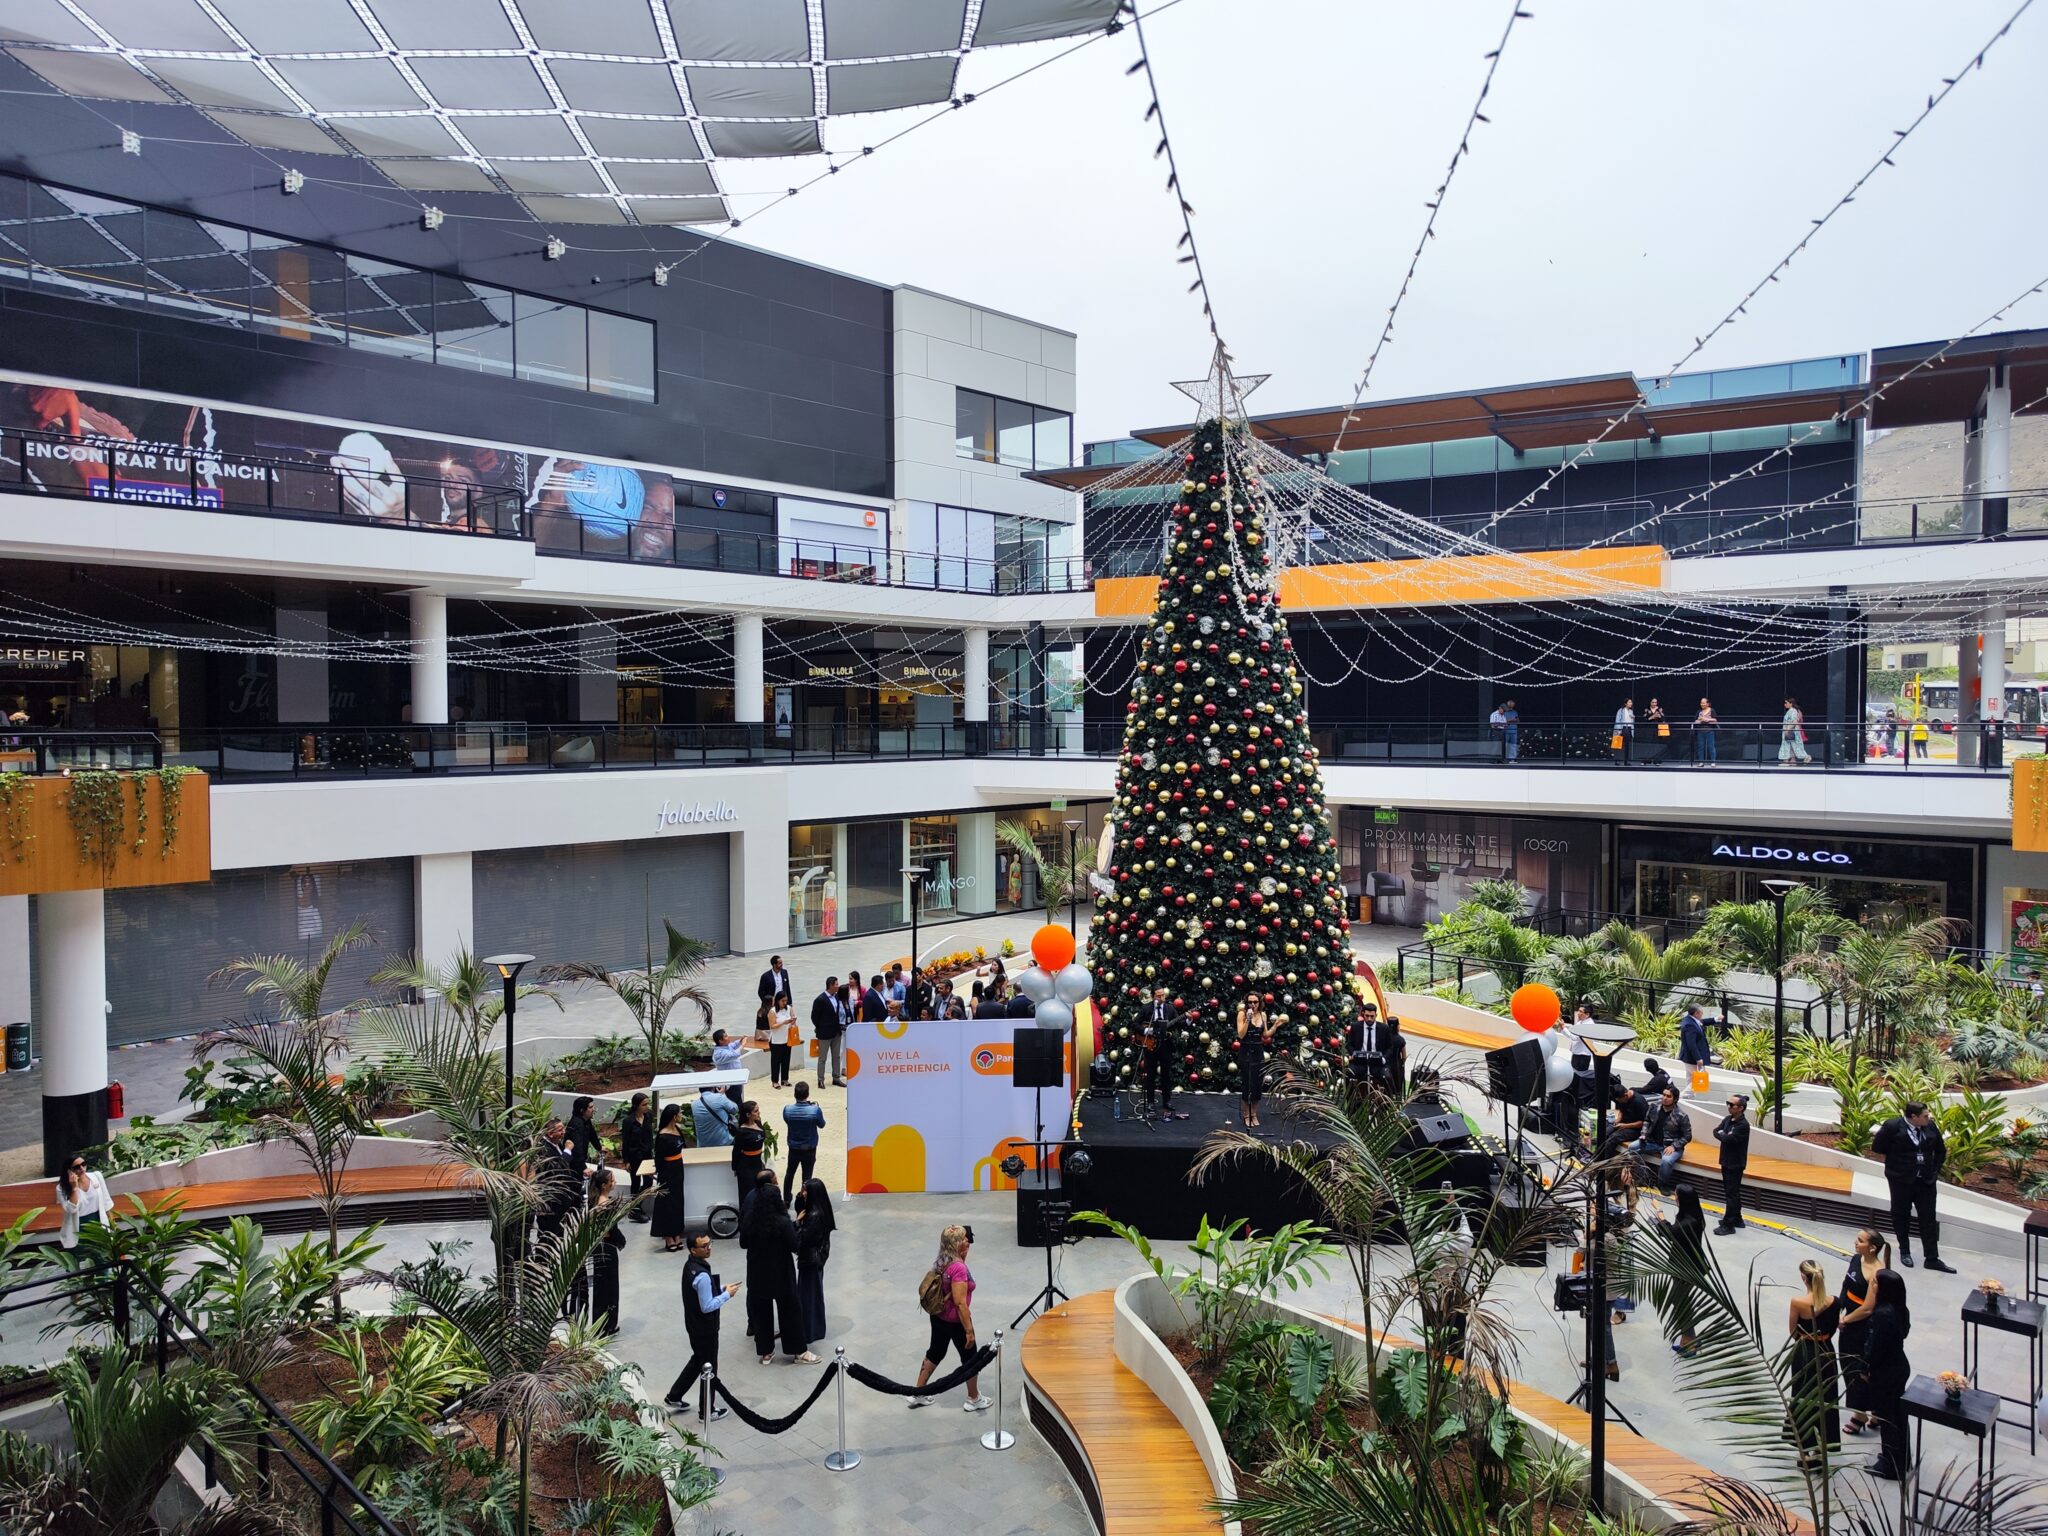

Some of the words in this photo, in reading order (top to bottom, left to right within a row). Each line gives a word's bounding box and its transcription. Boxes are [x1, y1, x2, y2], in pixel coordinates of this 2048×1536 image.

[163, 456, 186, 472] TU
[808, 666, 829, 676] BIMBA
[836, 666, 853, 675] LOLA
[903, 666, 929, 676] BIMBA
[938, 668, 958, 677] LOLA
[1364, 828, 1497, 848] PRÓXIMAMENTE
[1523, 838, 1568, 853] rosen
[1713, 845, 1793, 860] ALDO
[1796, 851, 1810, 861] &
[925, 876, 976, 893] MANGO
[877, 1051, 902, 1060] VIVE
[906, 1051, 920, 1060] LA
[877, 1063, 951, 1074] EXPERIENCIA
